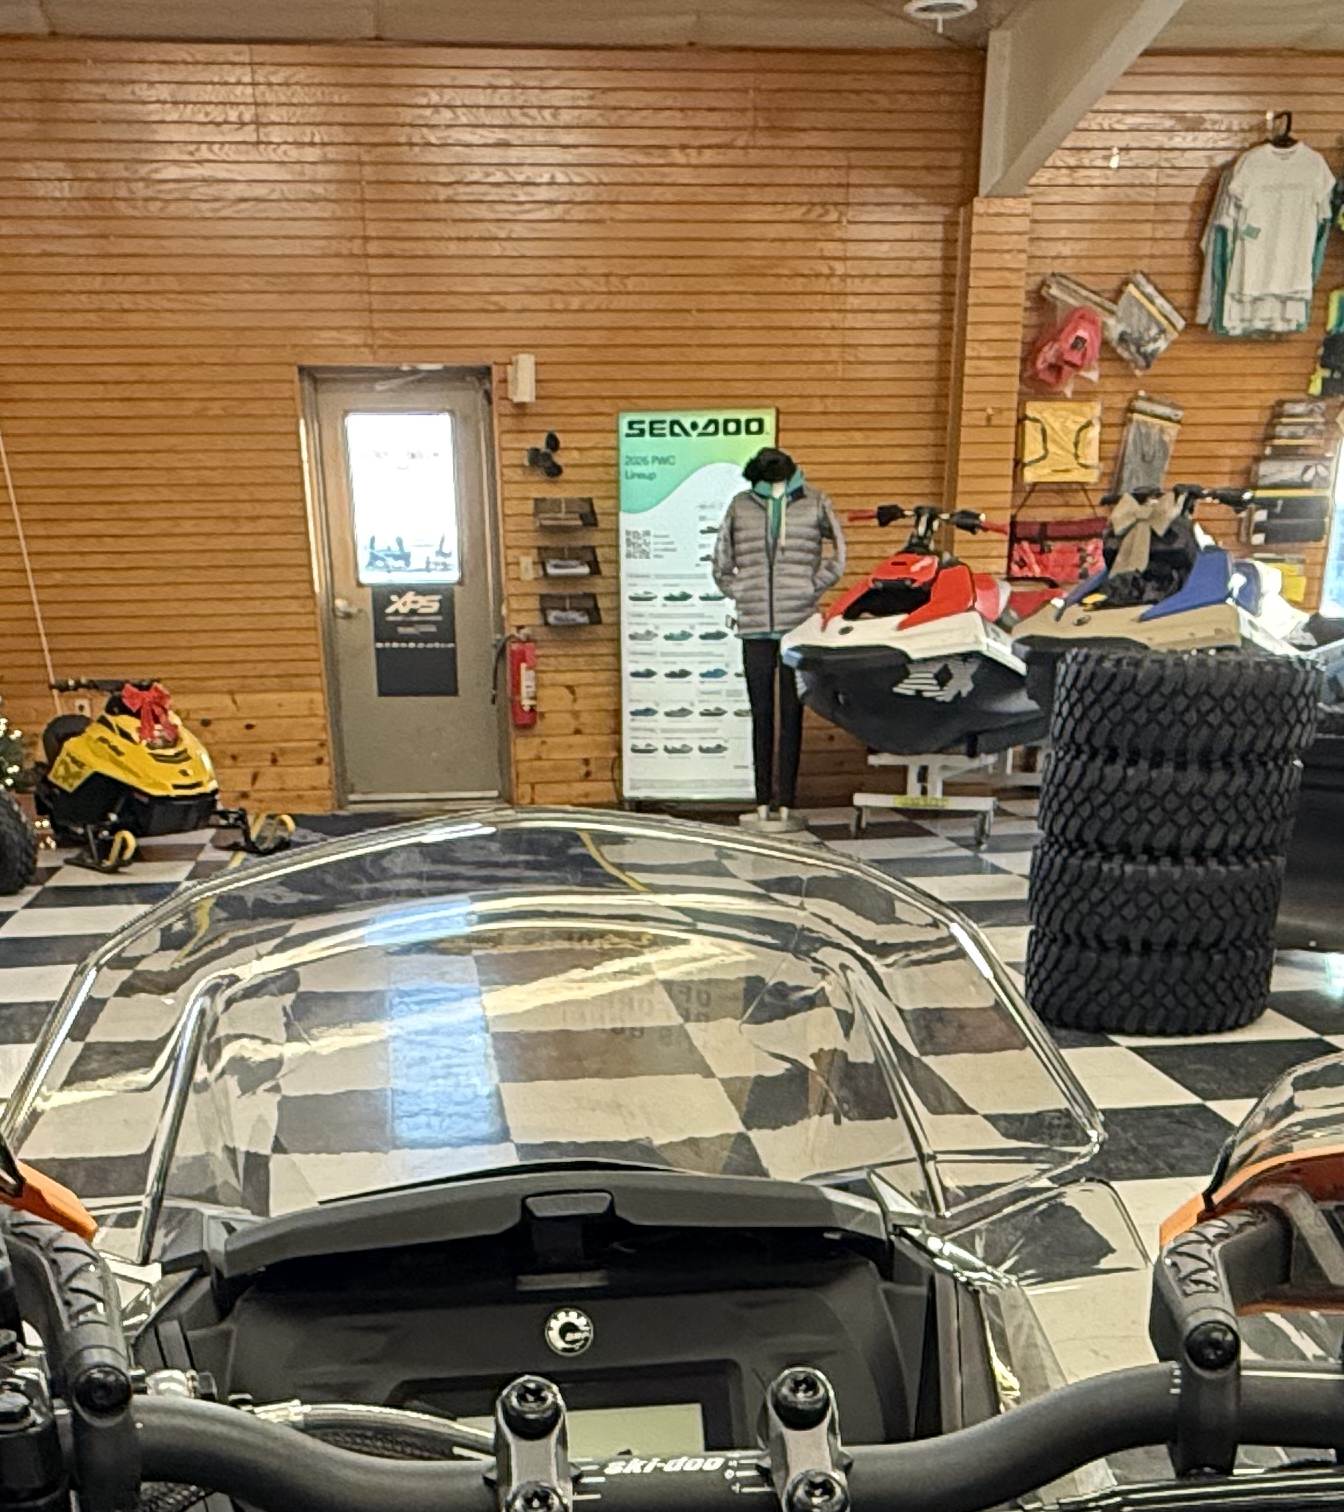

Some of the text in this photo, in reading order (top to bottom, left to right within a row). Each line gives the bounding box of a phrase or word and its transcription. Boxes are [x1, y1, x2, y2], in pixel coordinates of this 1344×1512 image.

[651, 455, 675, 465] PWC
[625, 472, 656, 481] Lineup
[385, 591, 443, 614] XPS
